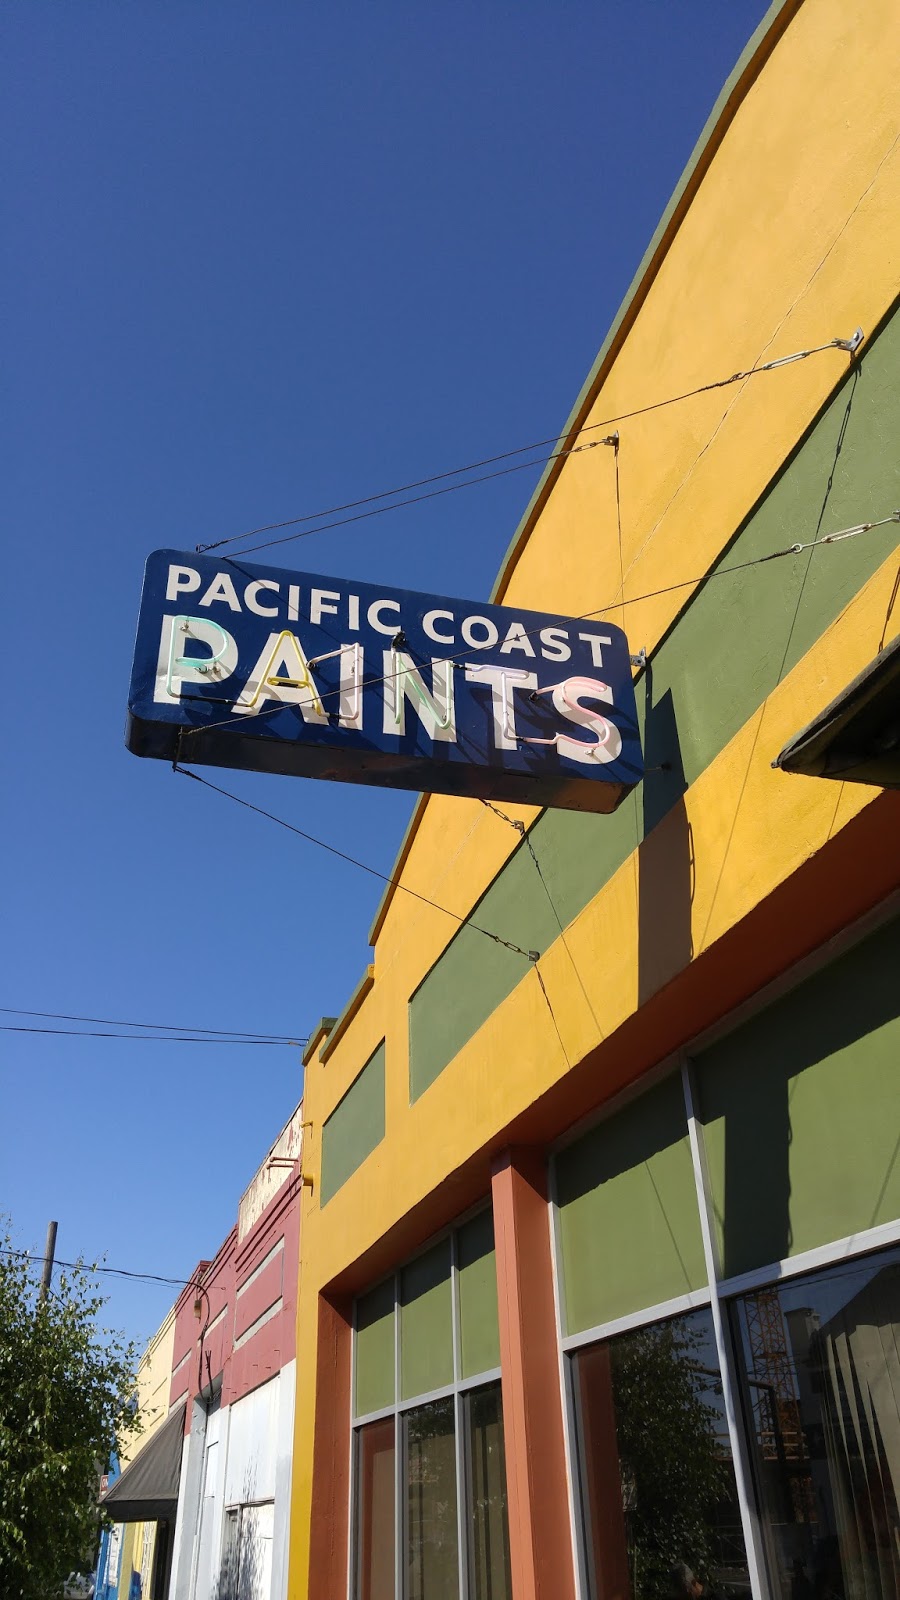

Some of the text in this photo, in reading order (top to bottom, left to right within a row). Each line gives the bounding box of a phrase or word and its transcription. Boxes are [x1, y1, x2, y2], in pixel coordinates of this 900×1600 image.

[166, 565, 612, 667] PACIFIC COAST
[153, 614, 623, 765] PAINTS
